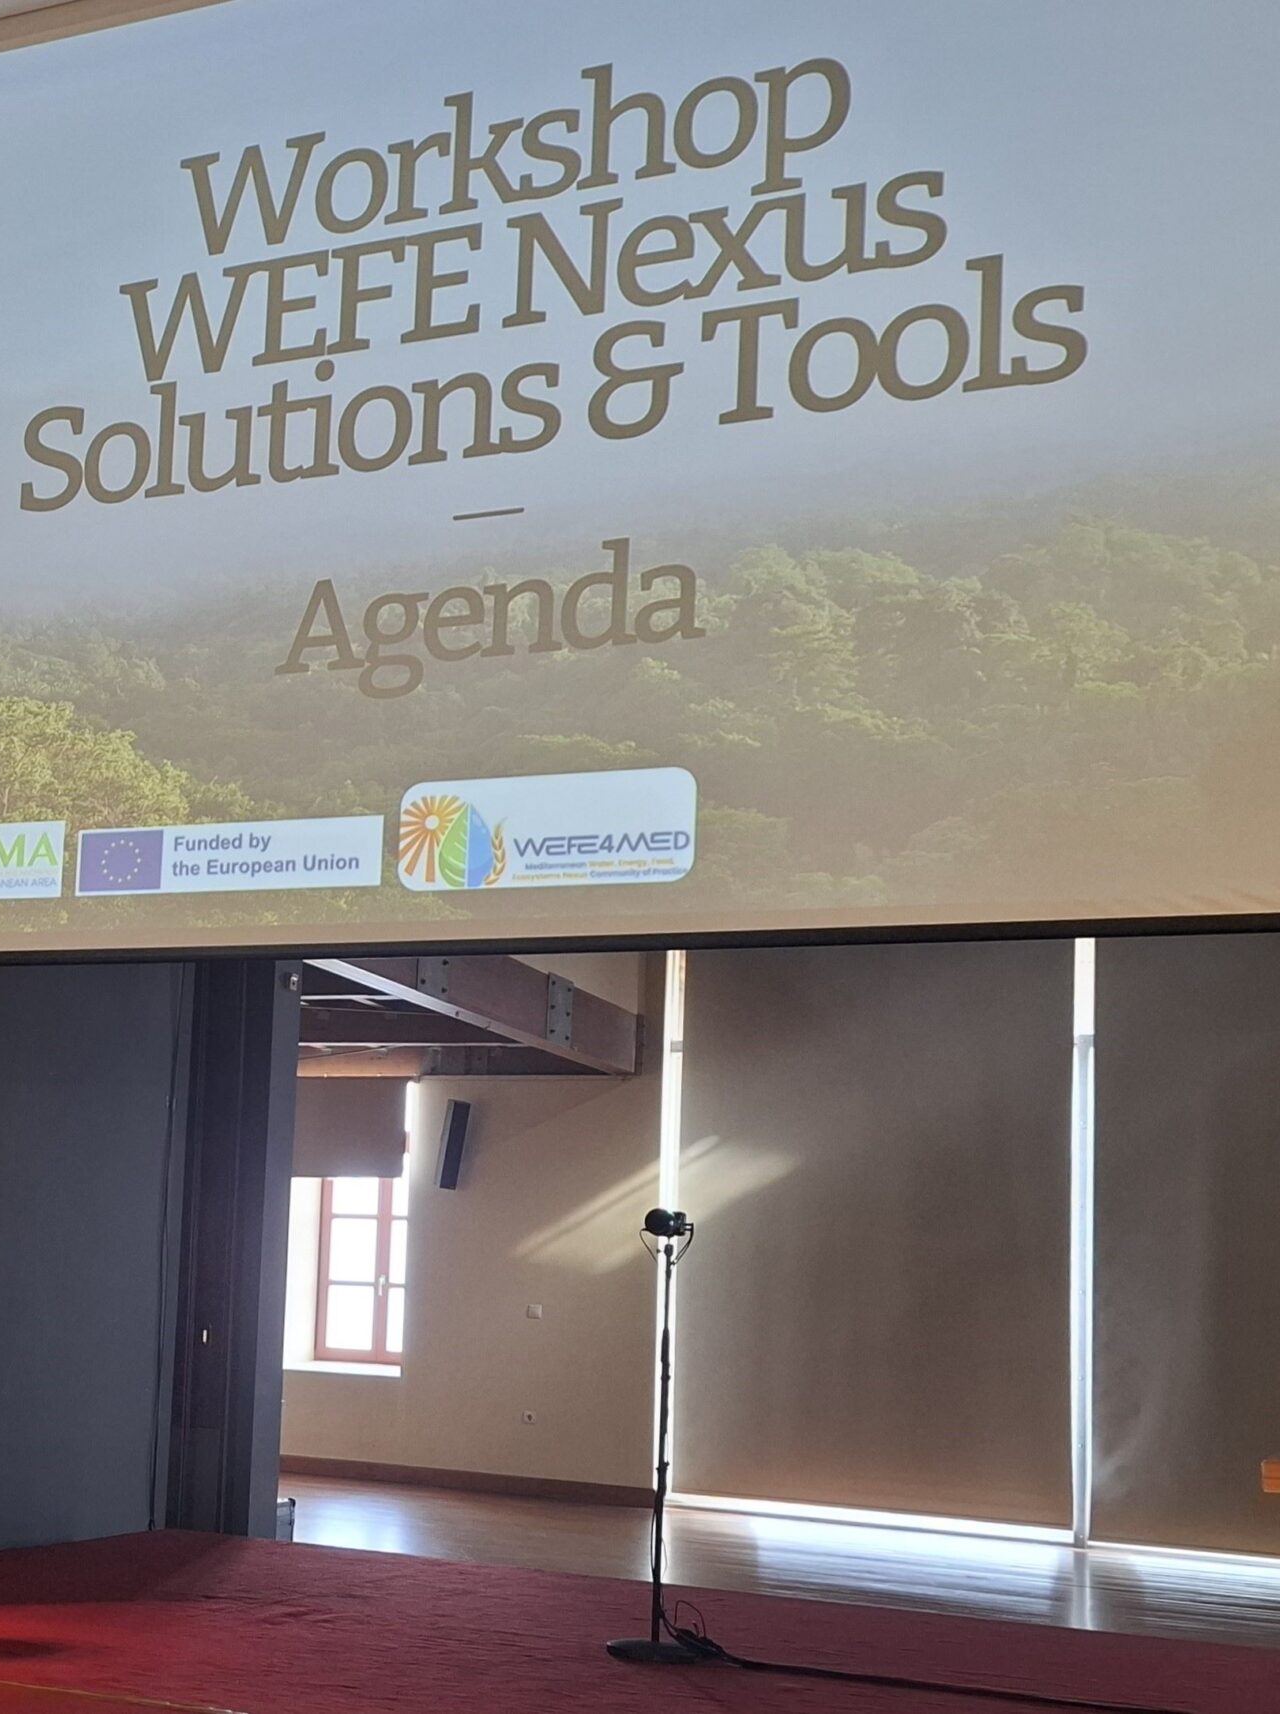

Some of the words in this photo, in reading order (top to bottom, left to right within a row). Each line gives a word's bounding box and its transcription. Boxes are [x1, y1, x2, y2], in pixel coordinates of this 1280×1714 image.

[179, 57, 852, 256] Workshop
[120, 223, 482, 381] WEFE
[503, 170, 948, 328] Nexus
[20, 361, 562, 512] Solutions
[586, 321, 684, 439] &
[701, 254, 1088, 425] Tools
[276, 537, 706, 700] Agenda
[30, 876, 57, 888] AREA
[171, 860, 201, 877] the
[206, 857, 297, 877] European
[302, 853, 360, 872] Union
[173, 833, 243, 852] Funded
[249, 833, 272, 852] by
[513, 831, 690, 858] WEFE4MED
